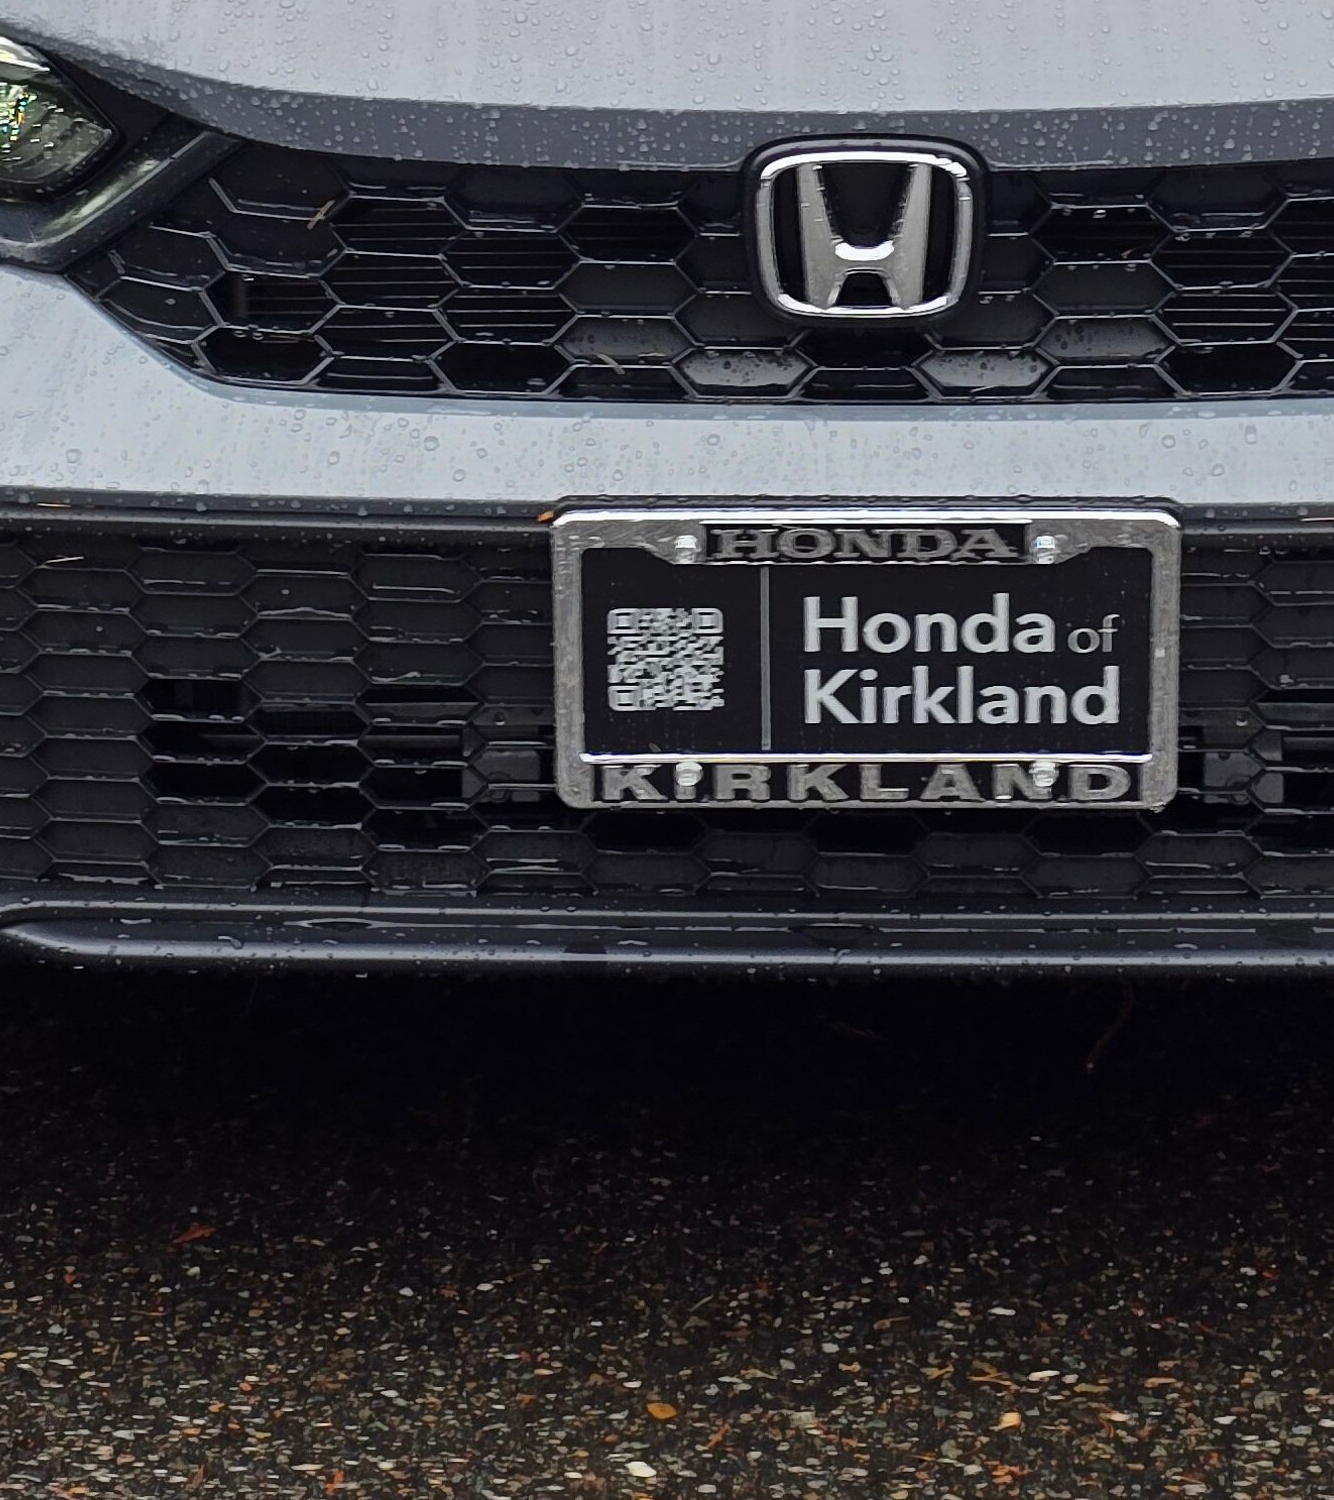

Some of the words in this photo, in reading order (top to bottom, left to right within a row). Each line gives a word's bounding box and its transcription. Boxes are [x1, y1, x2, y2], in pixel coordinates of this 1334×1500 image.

[710, 528, 1018, 559] HONDA
[803, 592, 1056, 654] Honda
[1067, 613, 1120, 654] of
[803, 665, 1120, 725] Kirkland
